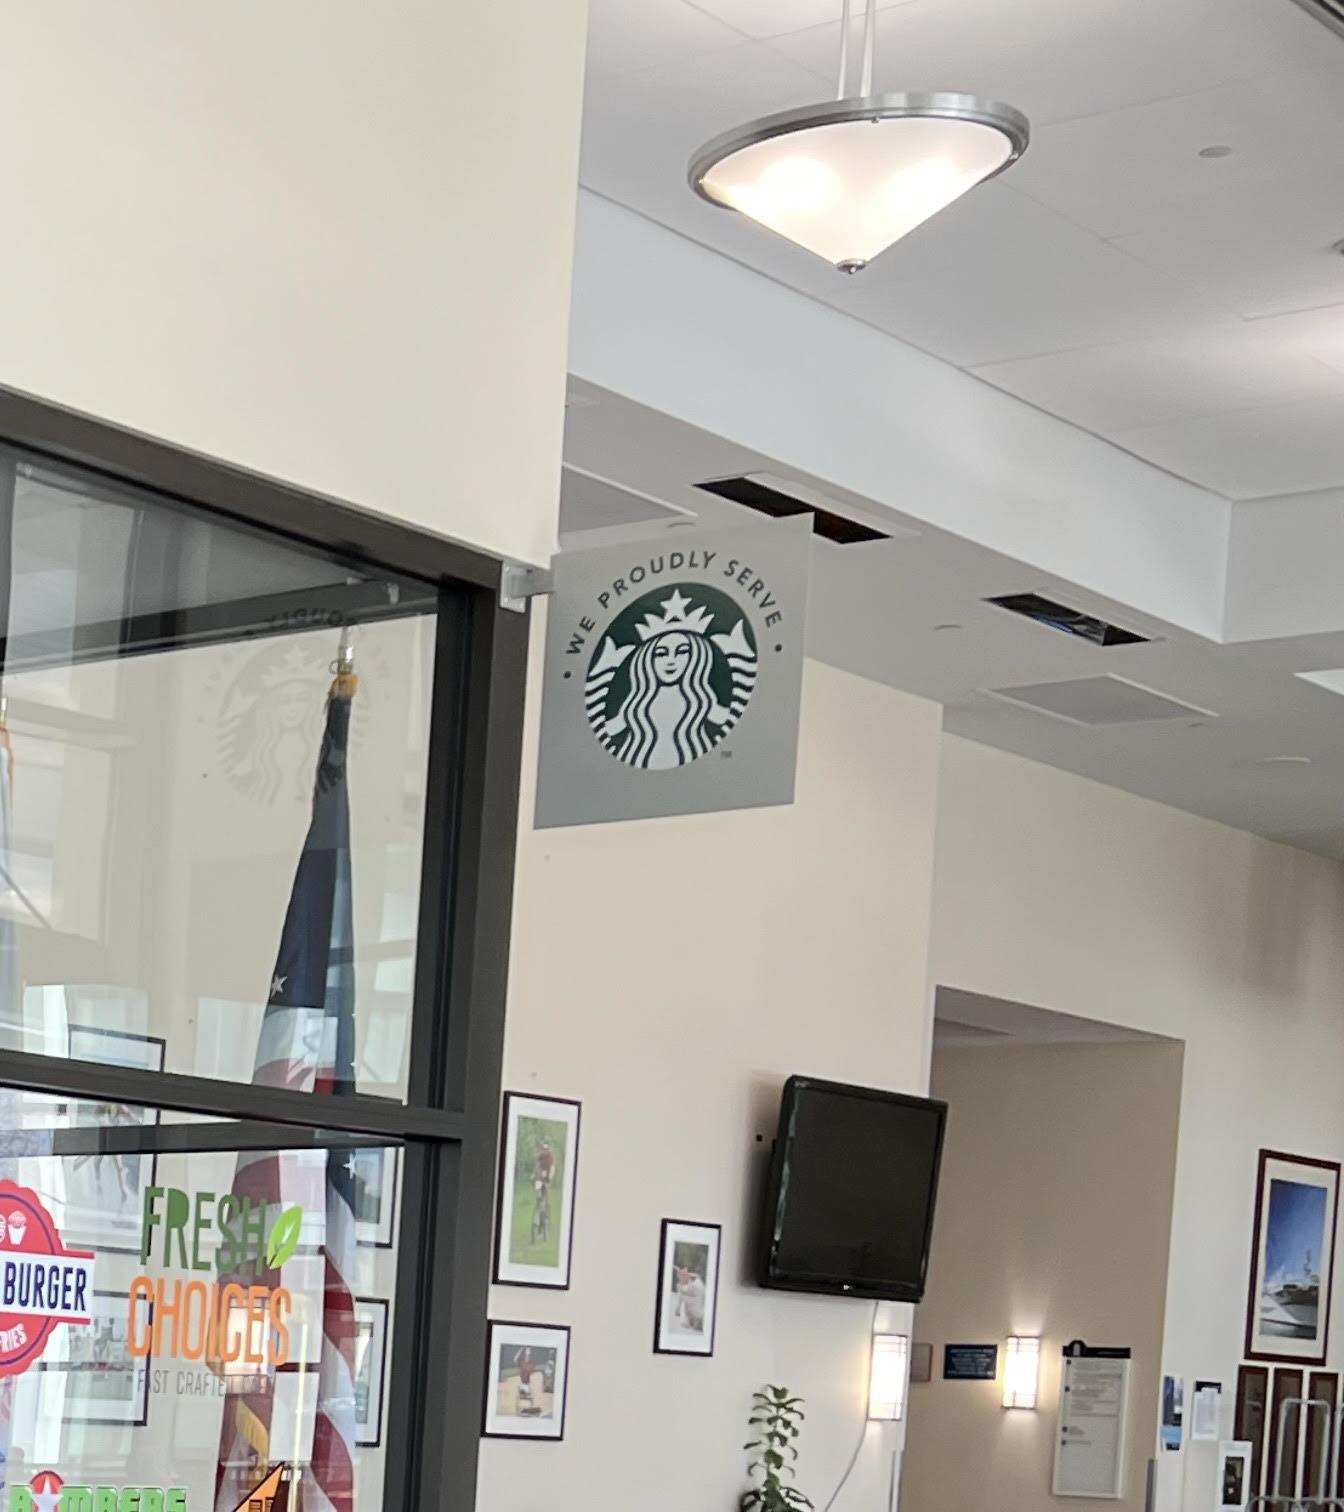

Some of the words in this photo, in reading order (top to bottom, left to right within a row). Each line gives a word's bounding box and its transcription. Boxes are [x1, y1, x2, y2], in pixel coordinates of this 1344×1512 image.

[565, 615, 597, 656] WE
[597, 550, 717, 609] PROUDLY
[724, 559, 782, 628] SERVE
[140, 1185, 267, 1275] FRESH
[3, 1260, 87, 1312] BURGER
[127, 1275, 292, 1367] CHOICES
